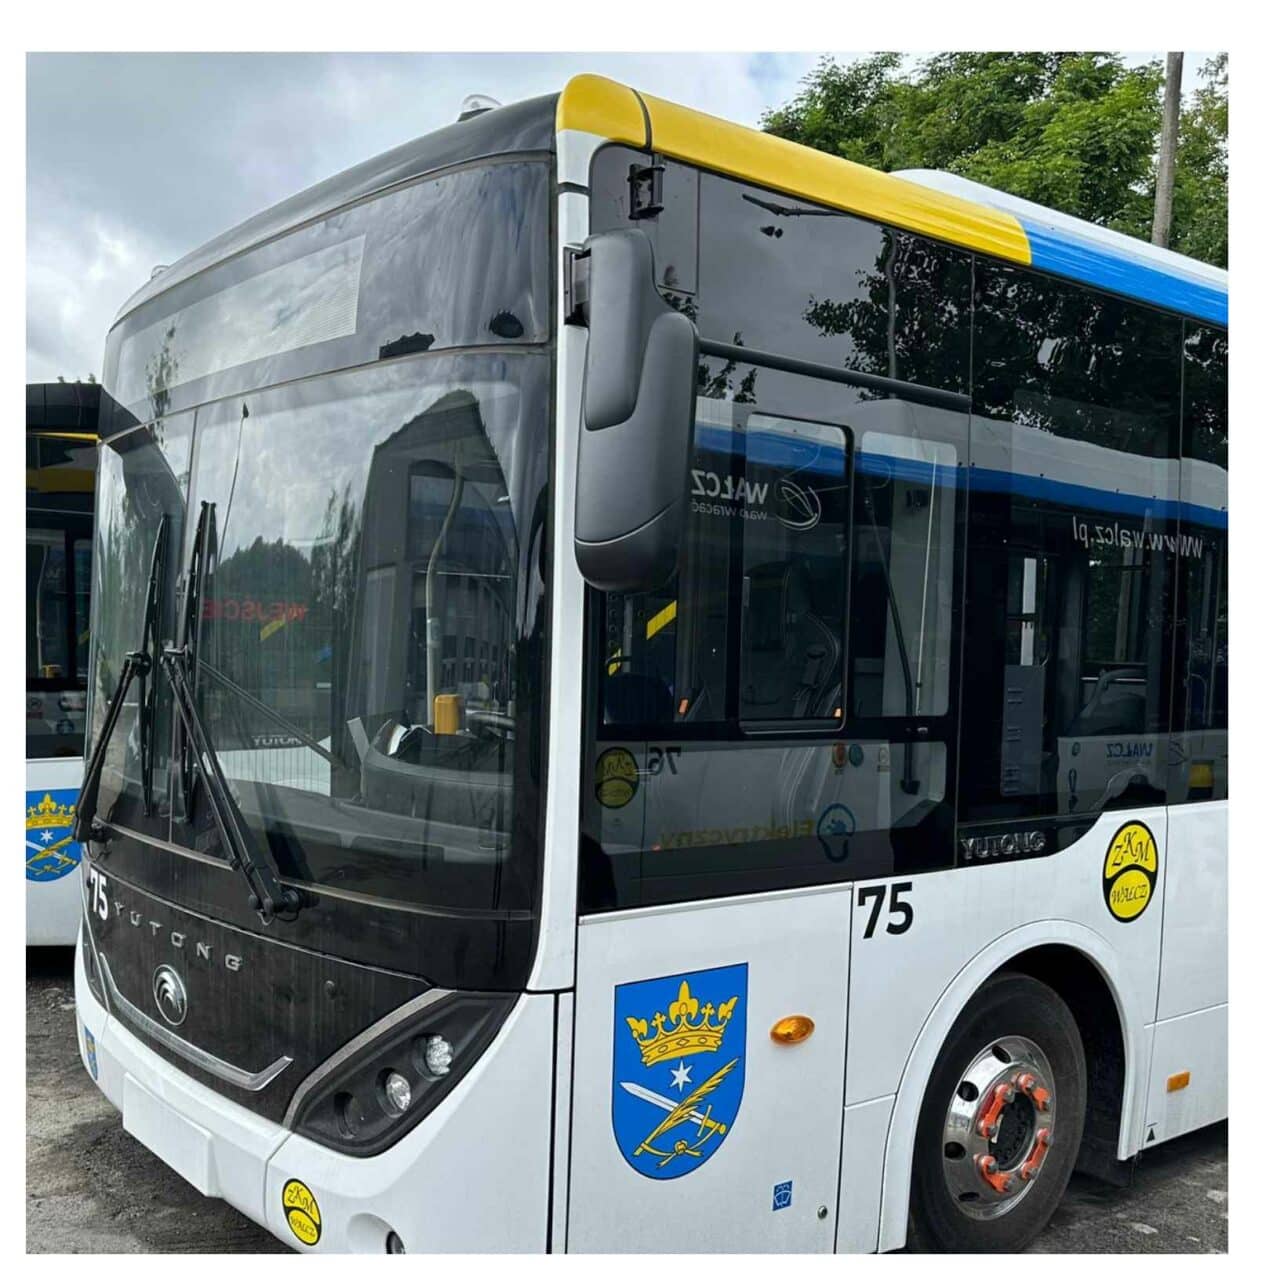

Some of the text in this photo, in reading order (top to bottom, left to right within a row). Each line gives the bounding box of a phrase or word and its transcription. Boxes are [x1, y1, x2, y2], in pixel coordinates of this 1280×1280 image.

[960, 831, 1045, 860] YUTONG
[1112, 830, 1152, 867] ZKM
[90, 869, 109, 920] 75
[857, 881, 914, 939] 75
[114, 902, 242, 971] YUTONG
